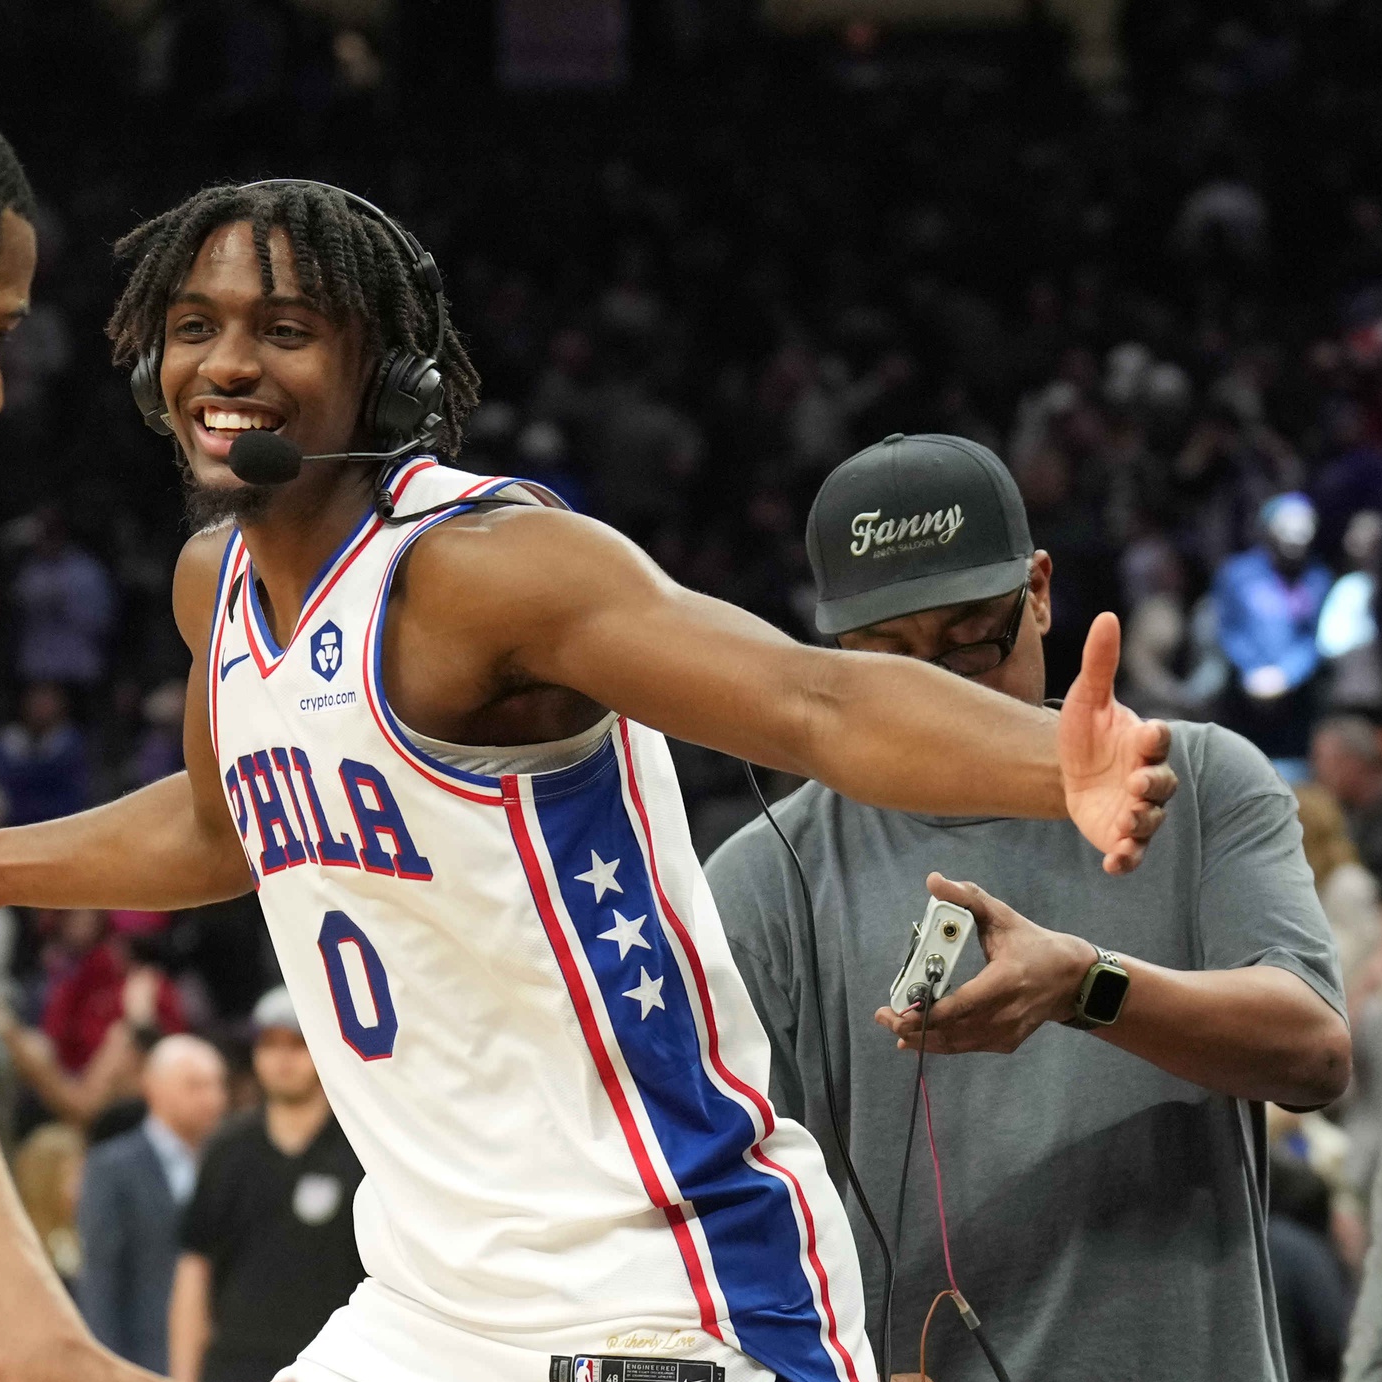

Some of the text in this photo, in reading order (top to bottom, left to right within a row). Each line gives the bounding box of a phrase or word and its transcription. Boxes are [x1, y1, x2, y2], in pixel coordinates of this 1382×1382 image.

[850, 504, 965, 557] Fanny
[898, 538, 936, 553] SALOON
[299, 690, 357, 713] crypto.com
[225, 746, 433, 892] PHILA
[317, 909, 398, 1062] 0
[626, 1363, 676, 1372] ENGINEERED
